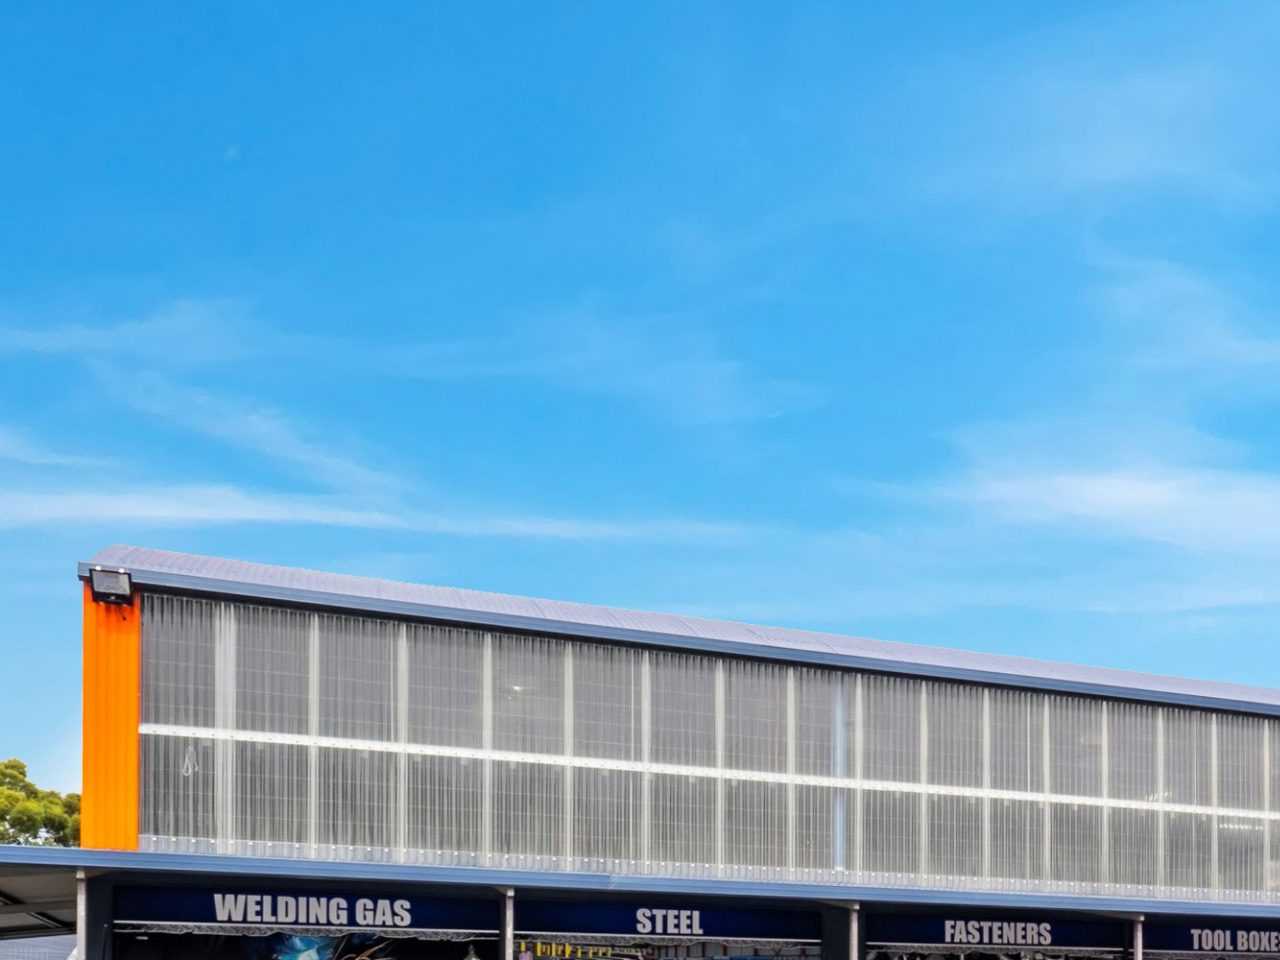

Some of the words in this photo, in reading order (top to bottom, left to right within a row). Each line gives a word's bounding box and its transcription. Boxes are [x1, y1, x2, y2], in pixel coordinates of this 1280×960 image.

[213, 893, 348, 925] WELDING
[355, 898, 412, 927] GAS
[636, 908, 704, 934] STEEL
[944, 919, 1052, 945] FASTENERS
[1190, 928, 1234, 951] TOOL
